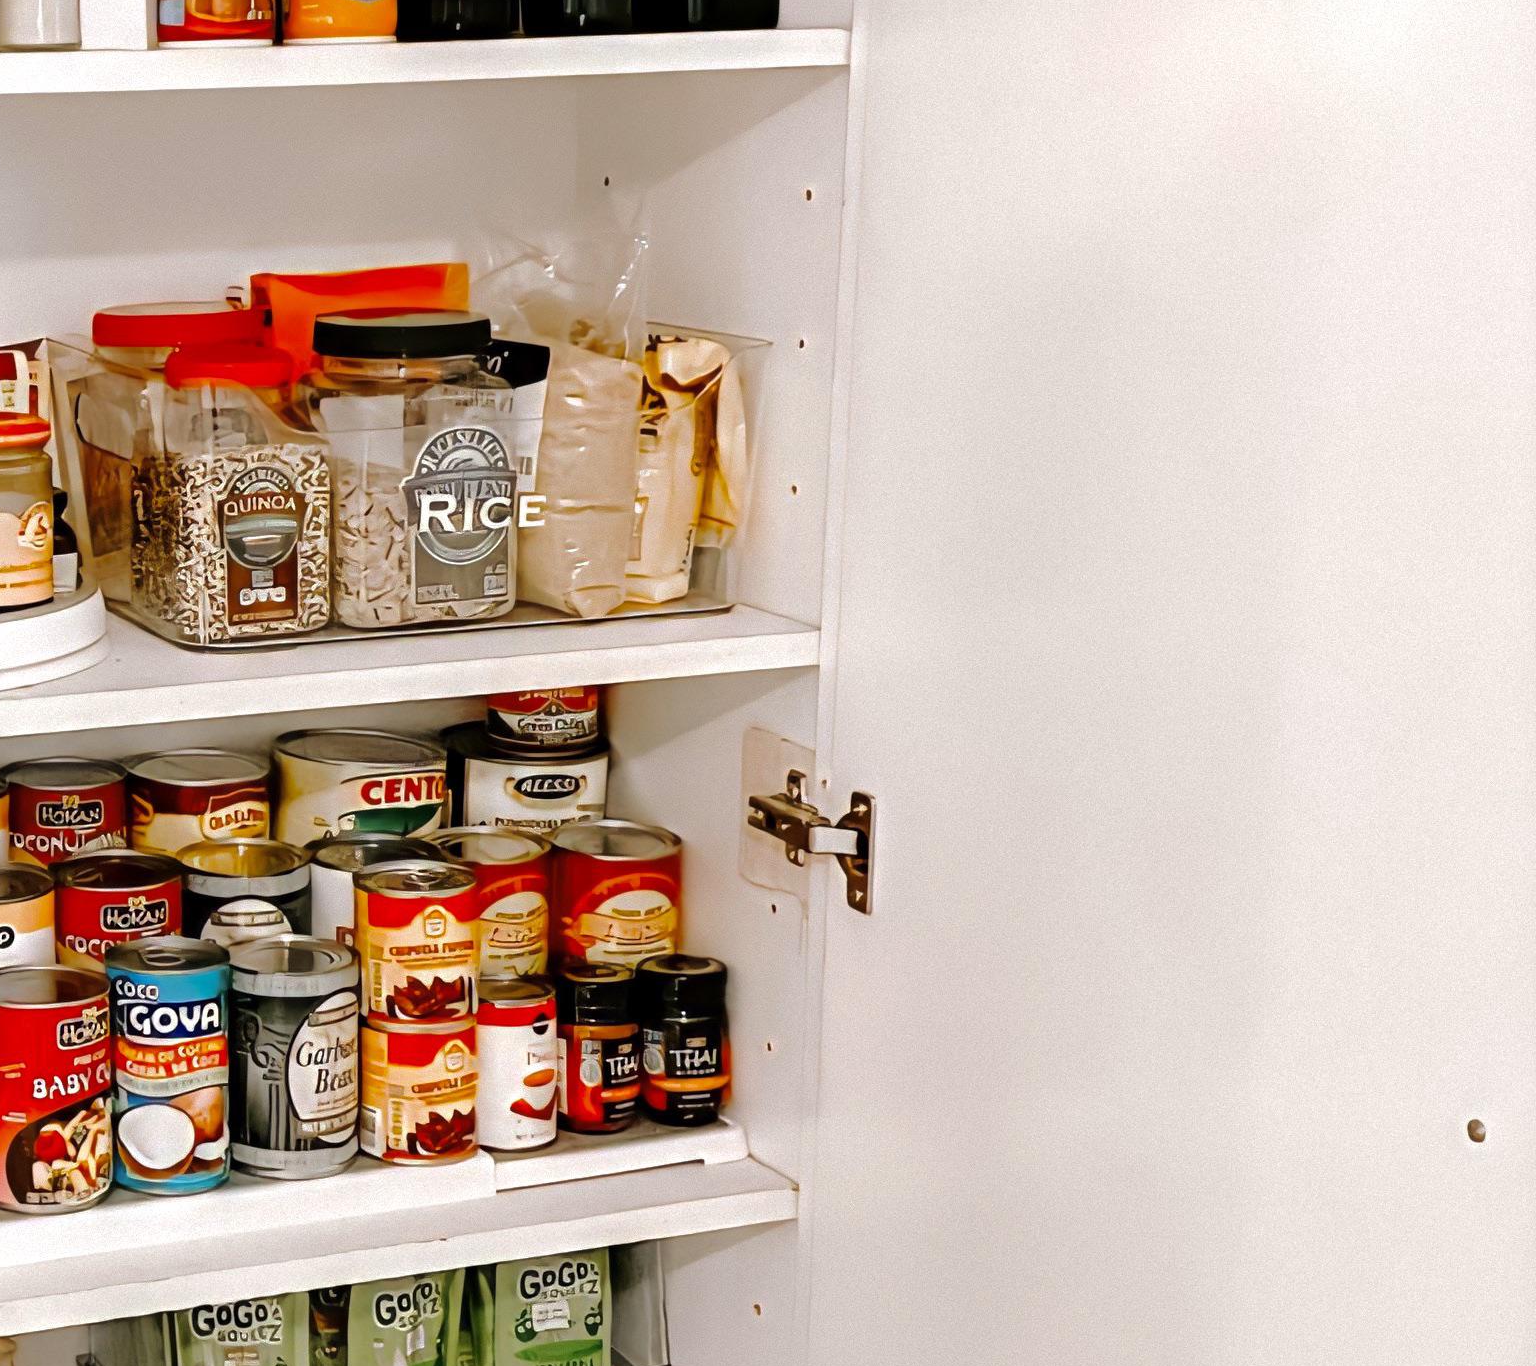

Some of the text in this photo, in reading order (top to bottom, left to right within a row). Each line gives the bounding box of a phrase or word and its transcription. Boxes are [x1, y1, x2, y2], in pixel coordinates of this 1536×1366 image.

[223, 494, 296, 517] QUINOA
[418, 493, 547, 533] RICE
[129, 1001, 220, 1036] GOYA
[669, 1048, 717, 1073] THAI
[32, 1068, 92, 1100] BABY
